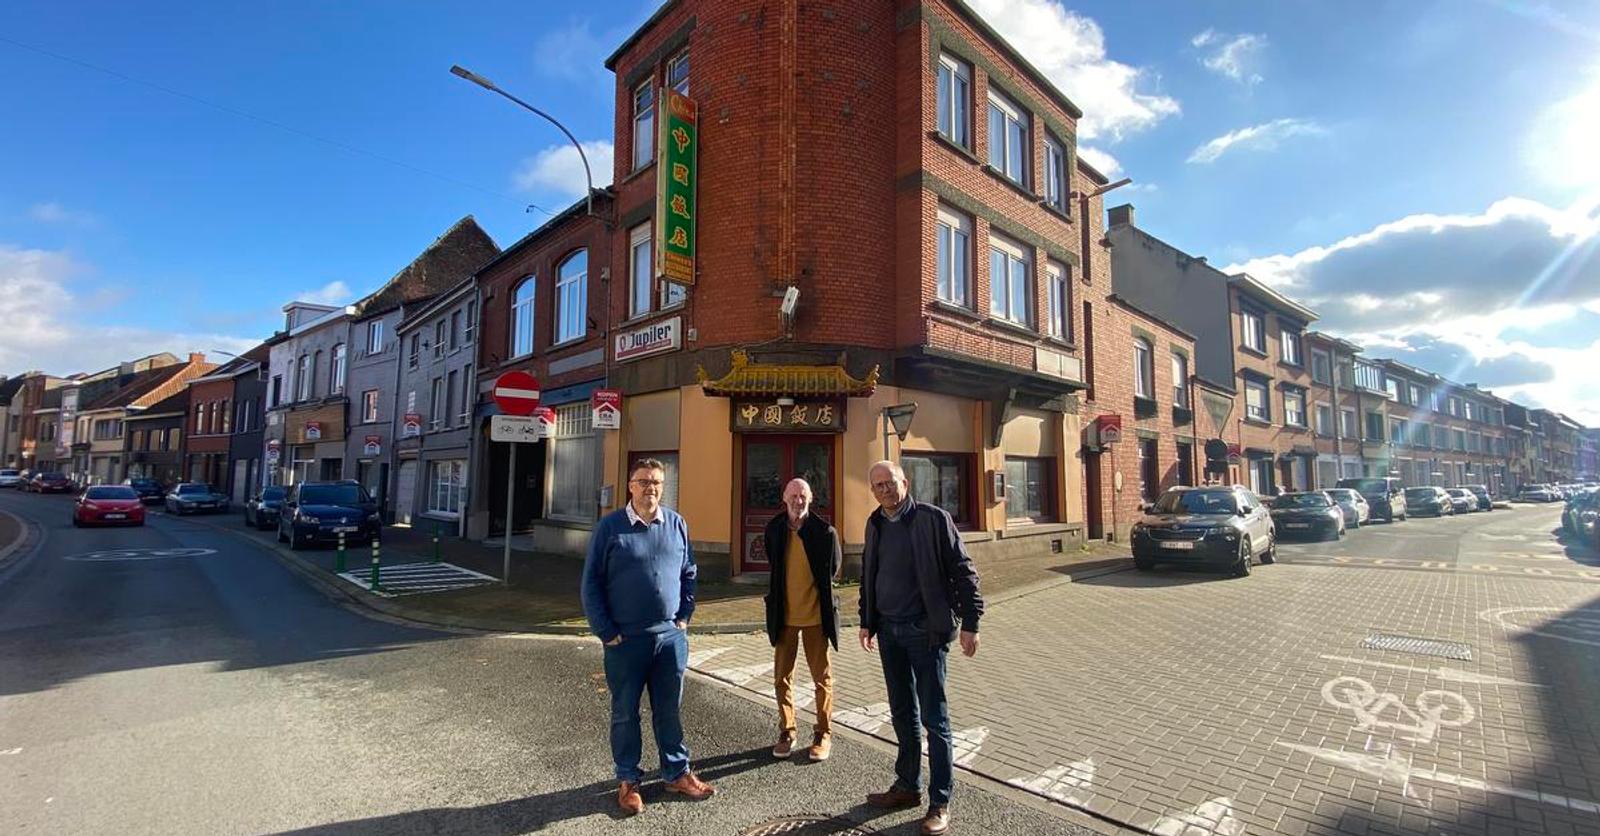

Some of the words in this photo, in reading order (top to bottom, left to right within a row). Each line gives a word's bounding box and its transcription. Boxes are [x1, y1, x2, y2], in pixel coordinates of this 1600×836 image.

[630, 325, 672, 348] Jupiler
[741, 404, 833, 425] 中國飯店
